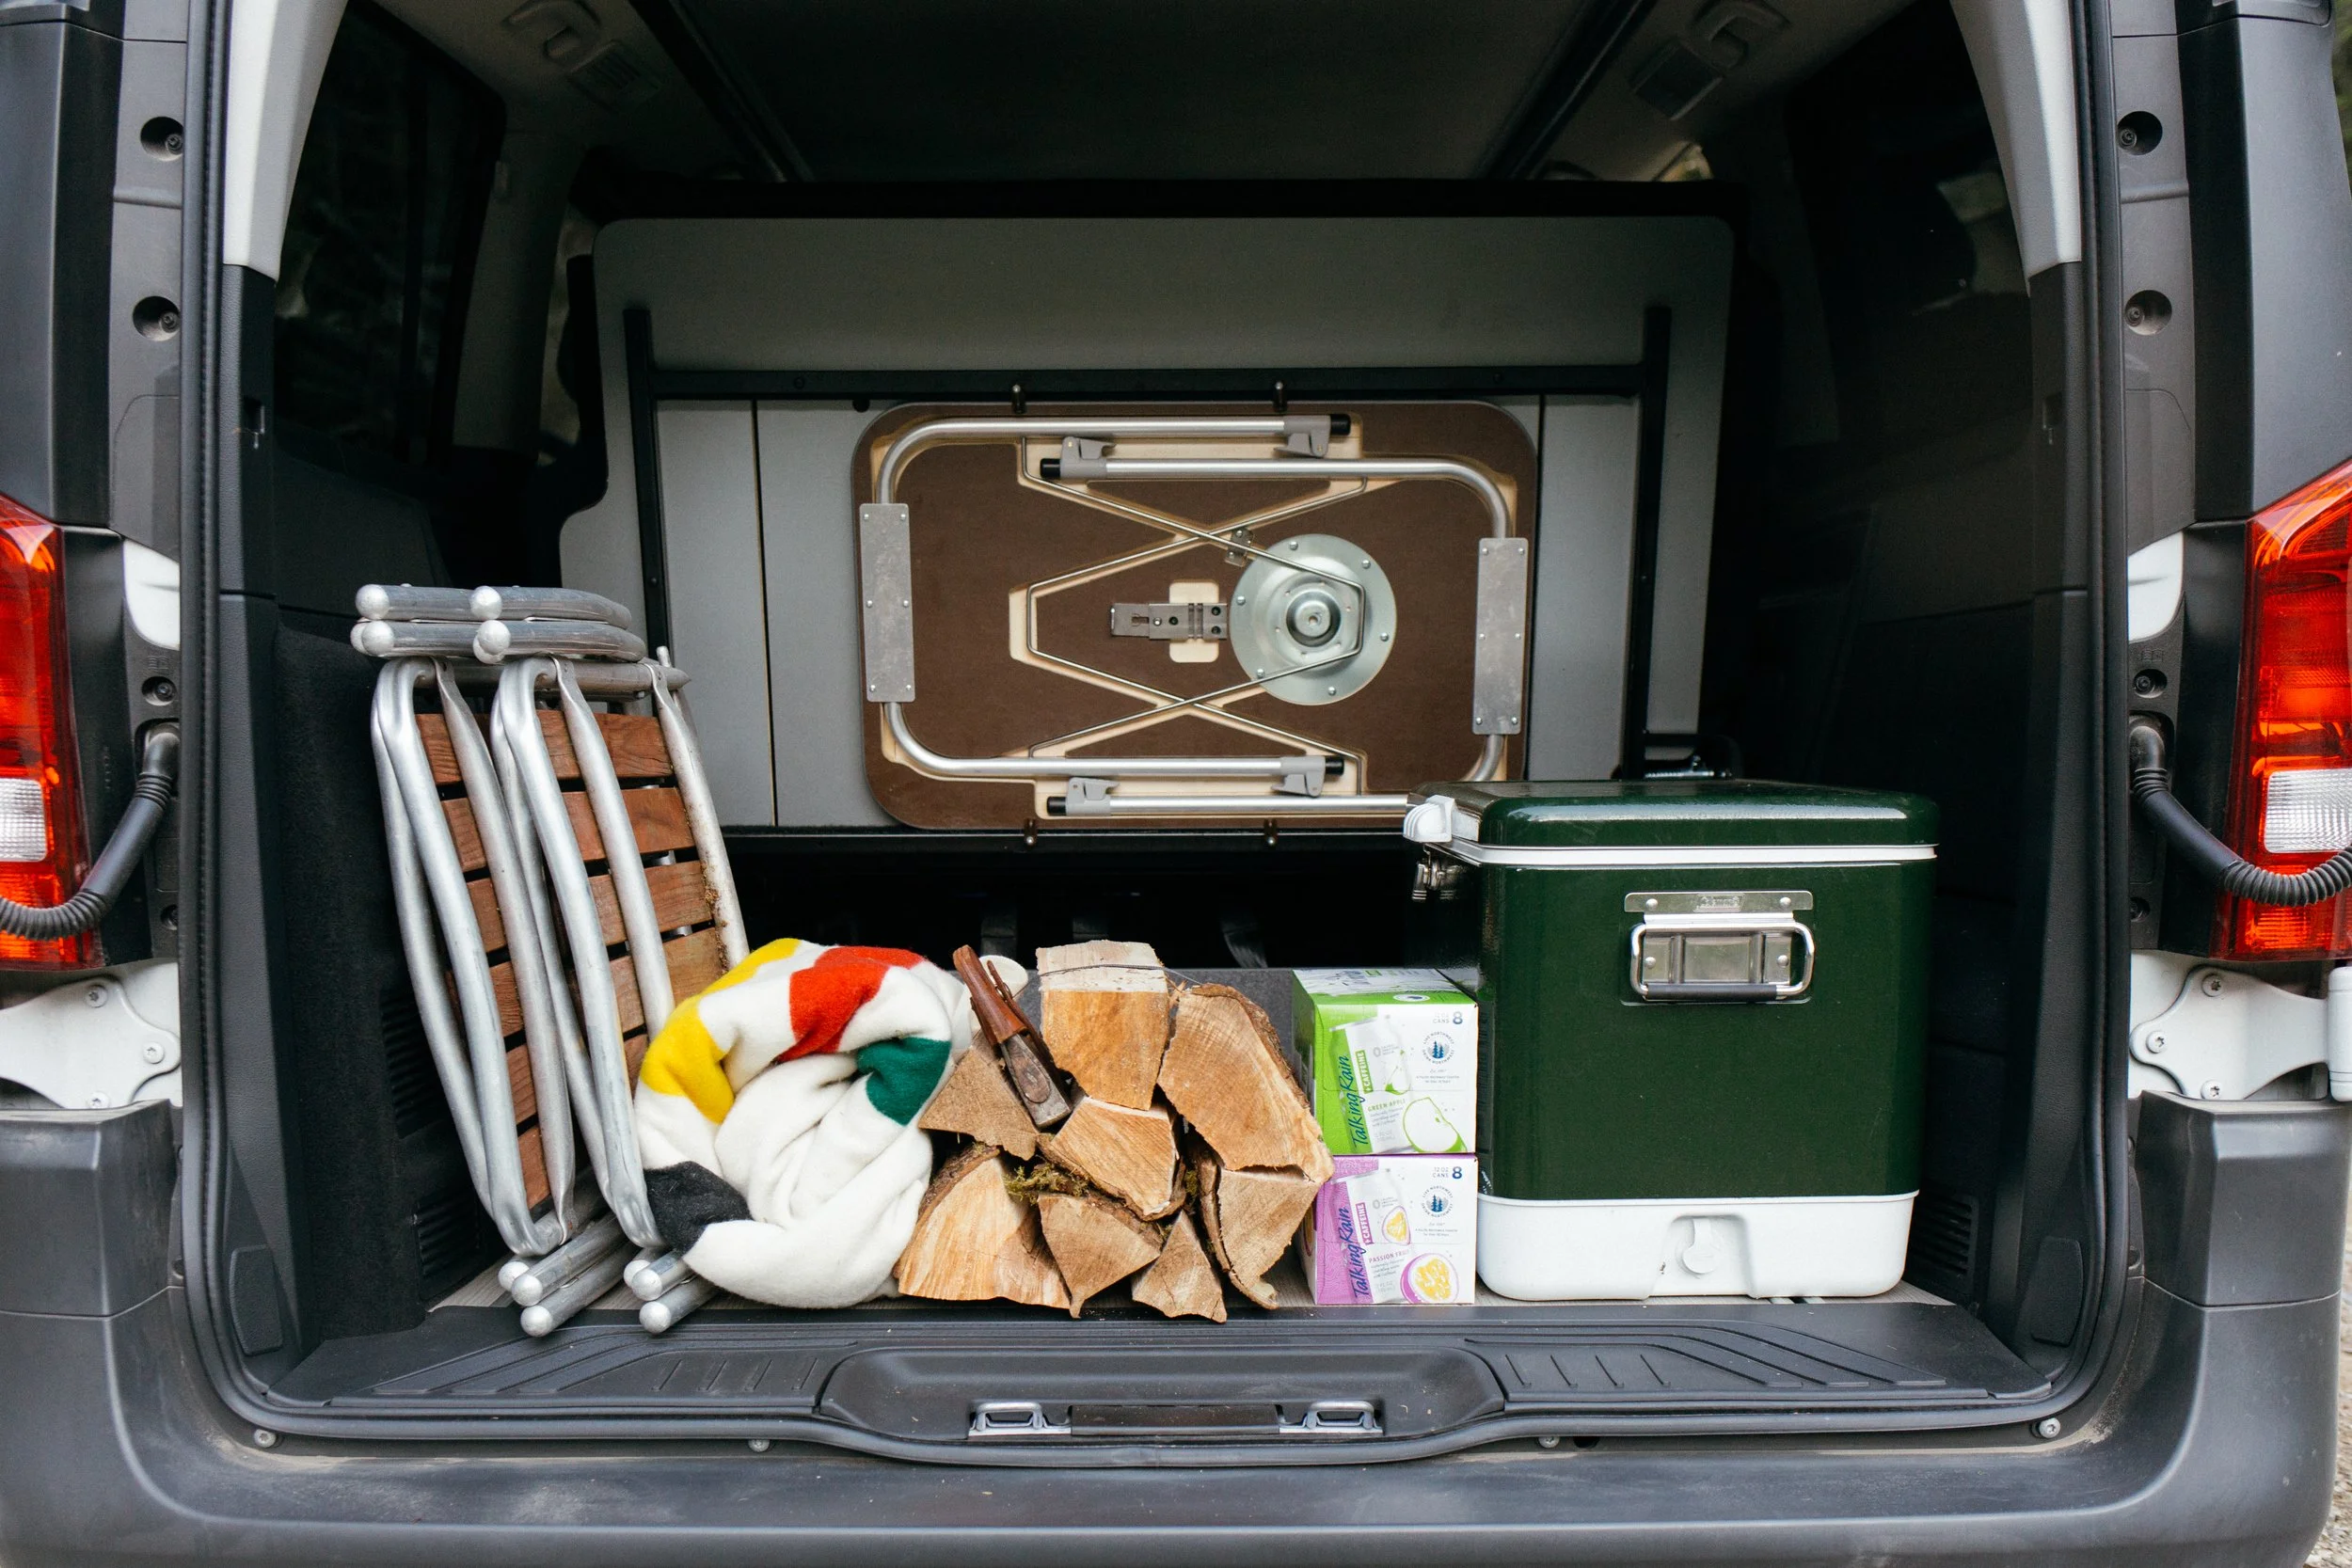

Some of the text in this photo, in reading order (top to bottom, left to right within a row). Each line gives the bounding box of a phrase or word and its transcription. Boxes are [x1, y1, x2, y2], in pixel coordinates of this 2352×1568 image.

[1453, 1011, 1463, 1024] 8
[1368, 1098, 1406, 1112] GREEN APPLE
[1452, 1166, 1463, 1179] 8
[1369, 1251, 1393, 1263] PASSION
